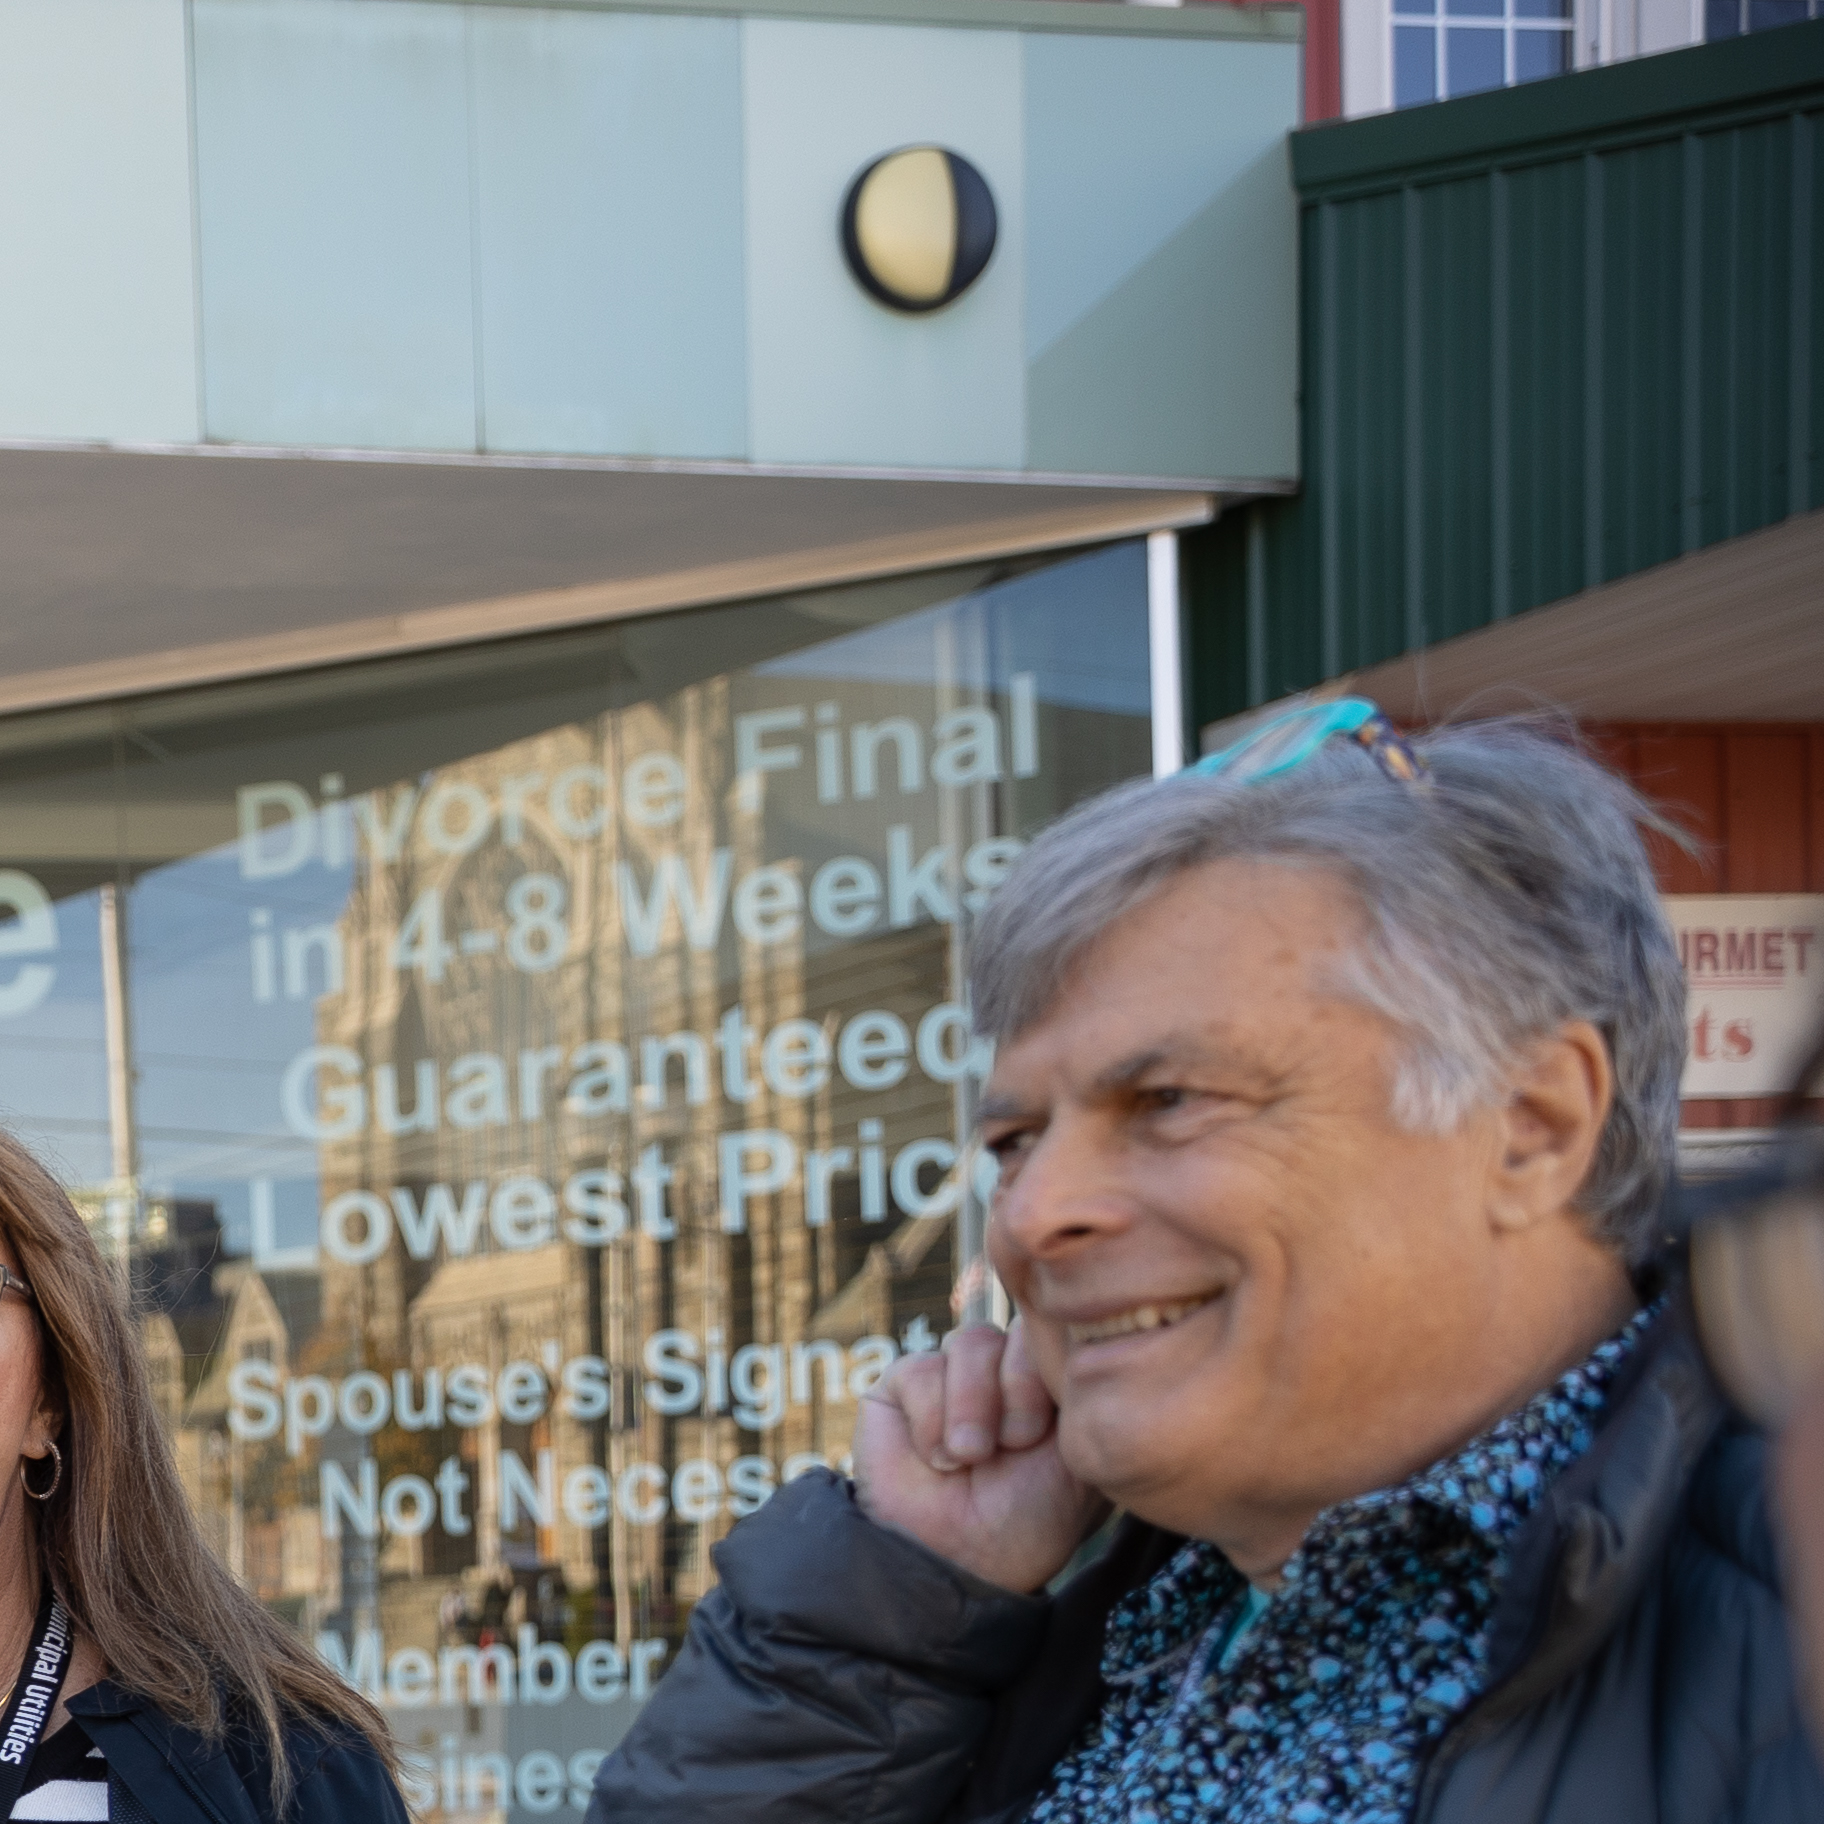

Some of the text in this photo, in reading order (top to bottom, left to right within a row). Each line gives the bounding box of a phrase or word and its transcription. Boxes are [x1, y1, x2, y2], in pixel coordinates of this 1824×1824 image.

[236, 672, 1040, 882] Divorce Final
[249, 823, 1028, 1000] in 4-8 Weeks
[249, 1138, 680, 1272] Lowest
[227, 1338, 611, 1457] Spouse's
[317, 1448, 855, 1539] Not Neces
